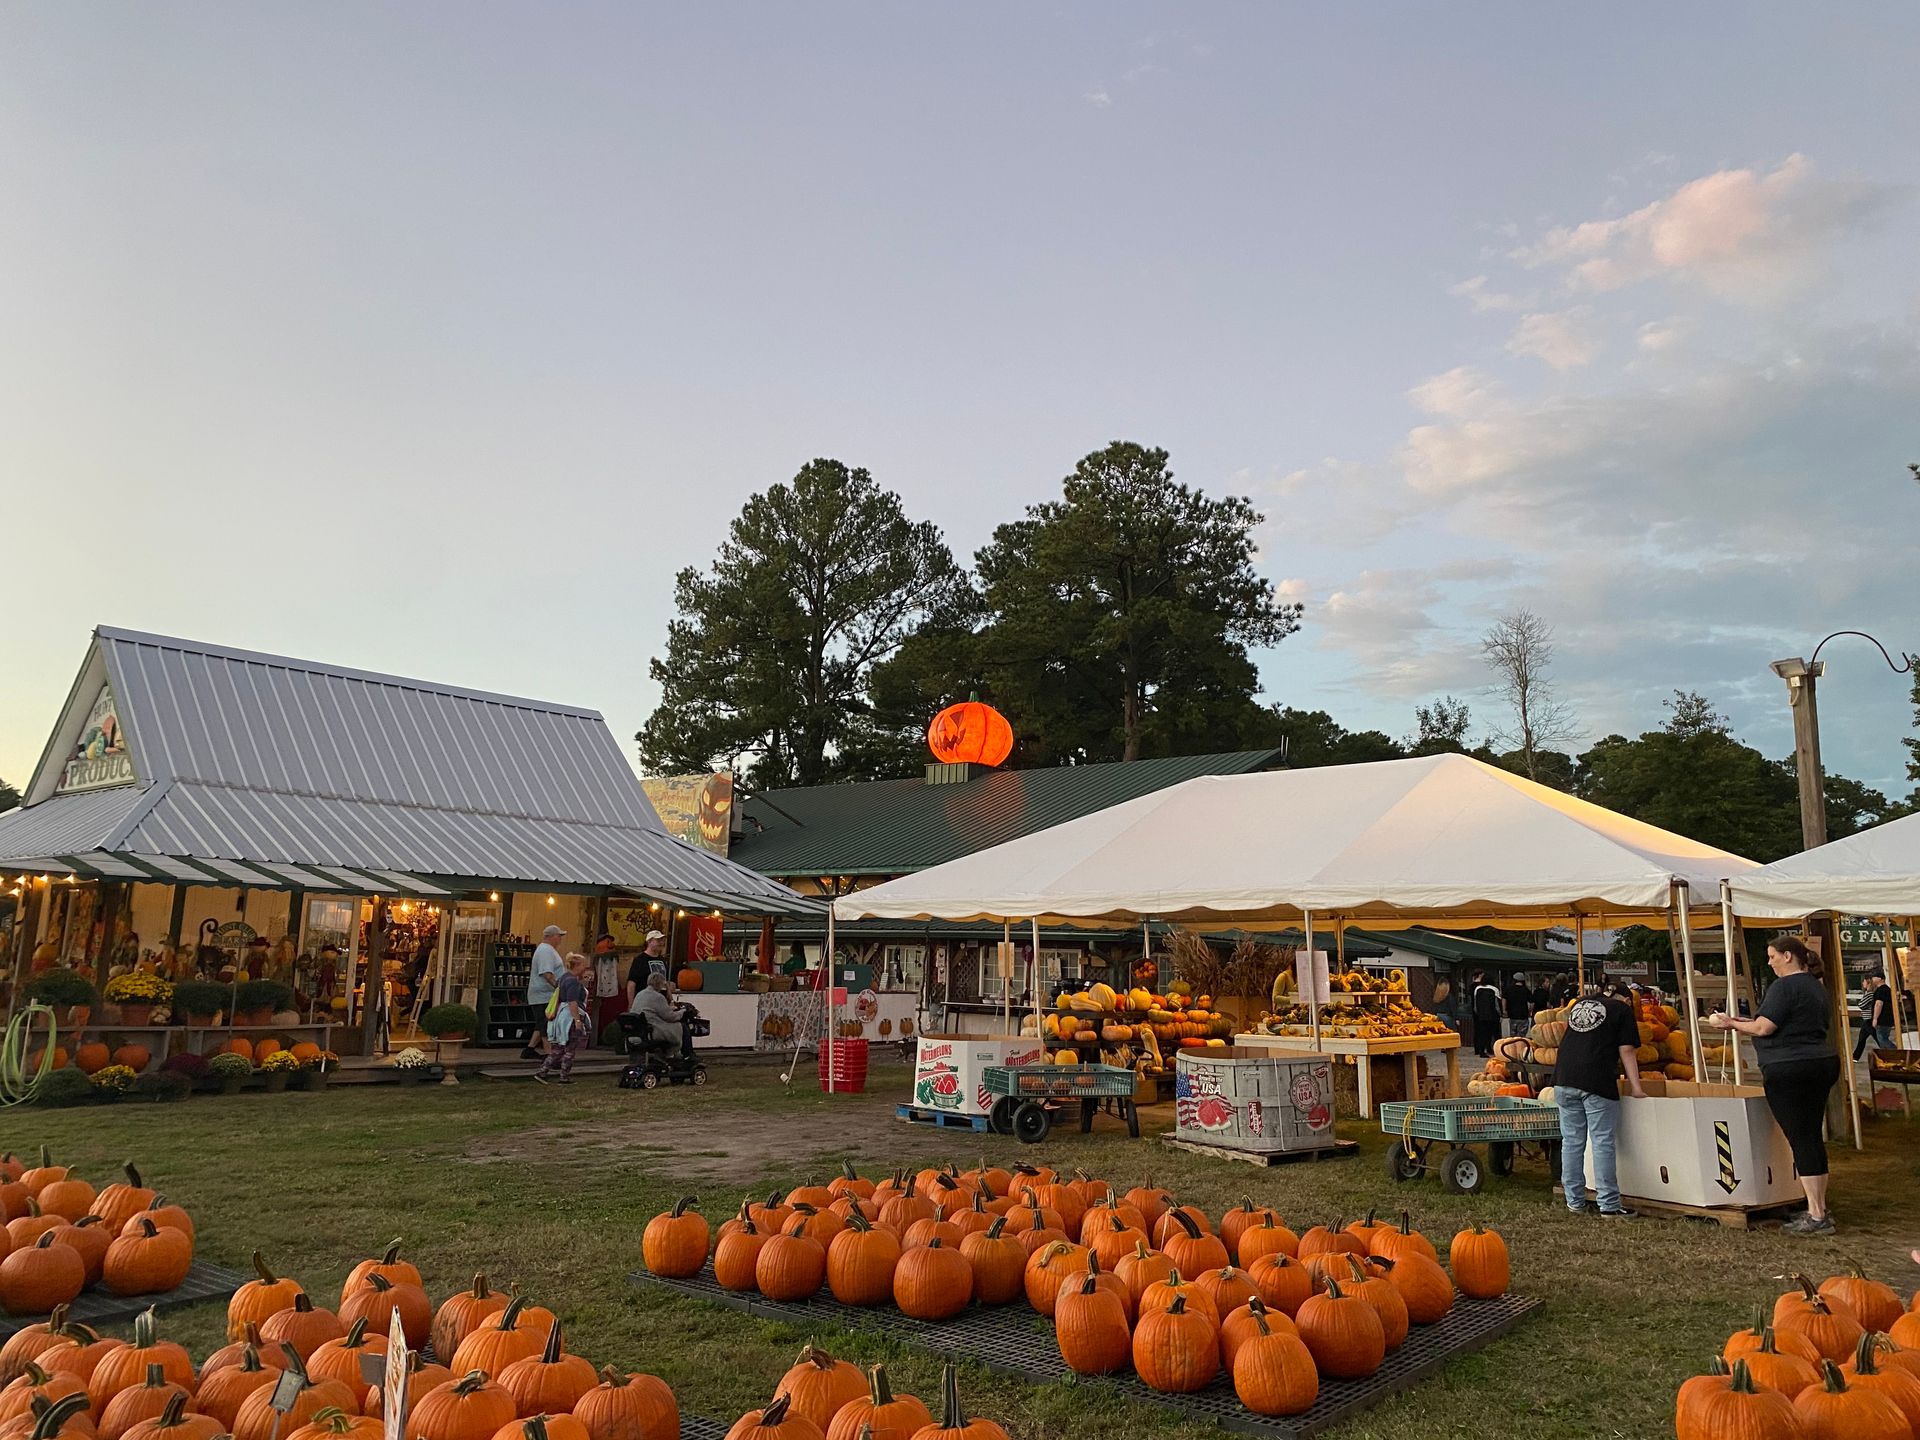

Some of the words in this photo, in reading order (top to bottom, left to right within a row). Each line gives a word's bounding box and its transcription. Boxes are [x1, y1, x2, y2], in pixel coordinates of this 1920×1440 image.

[67, 756, 133, 787] PRODUC
[1858, 930, 1910, 943] FARM
[1202, 1082, 1222, 1095] USA
